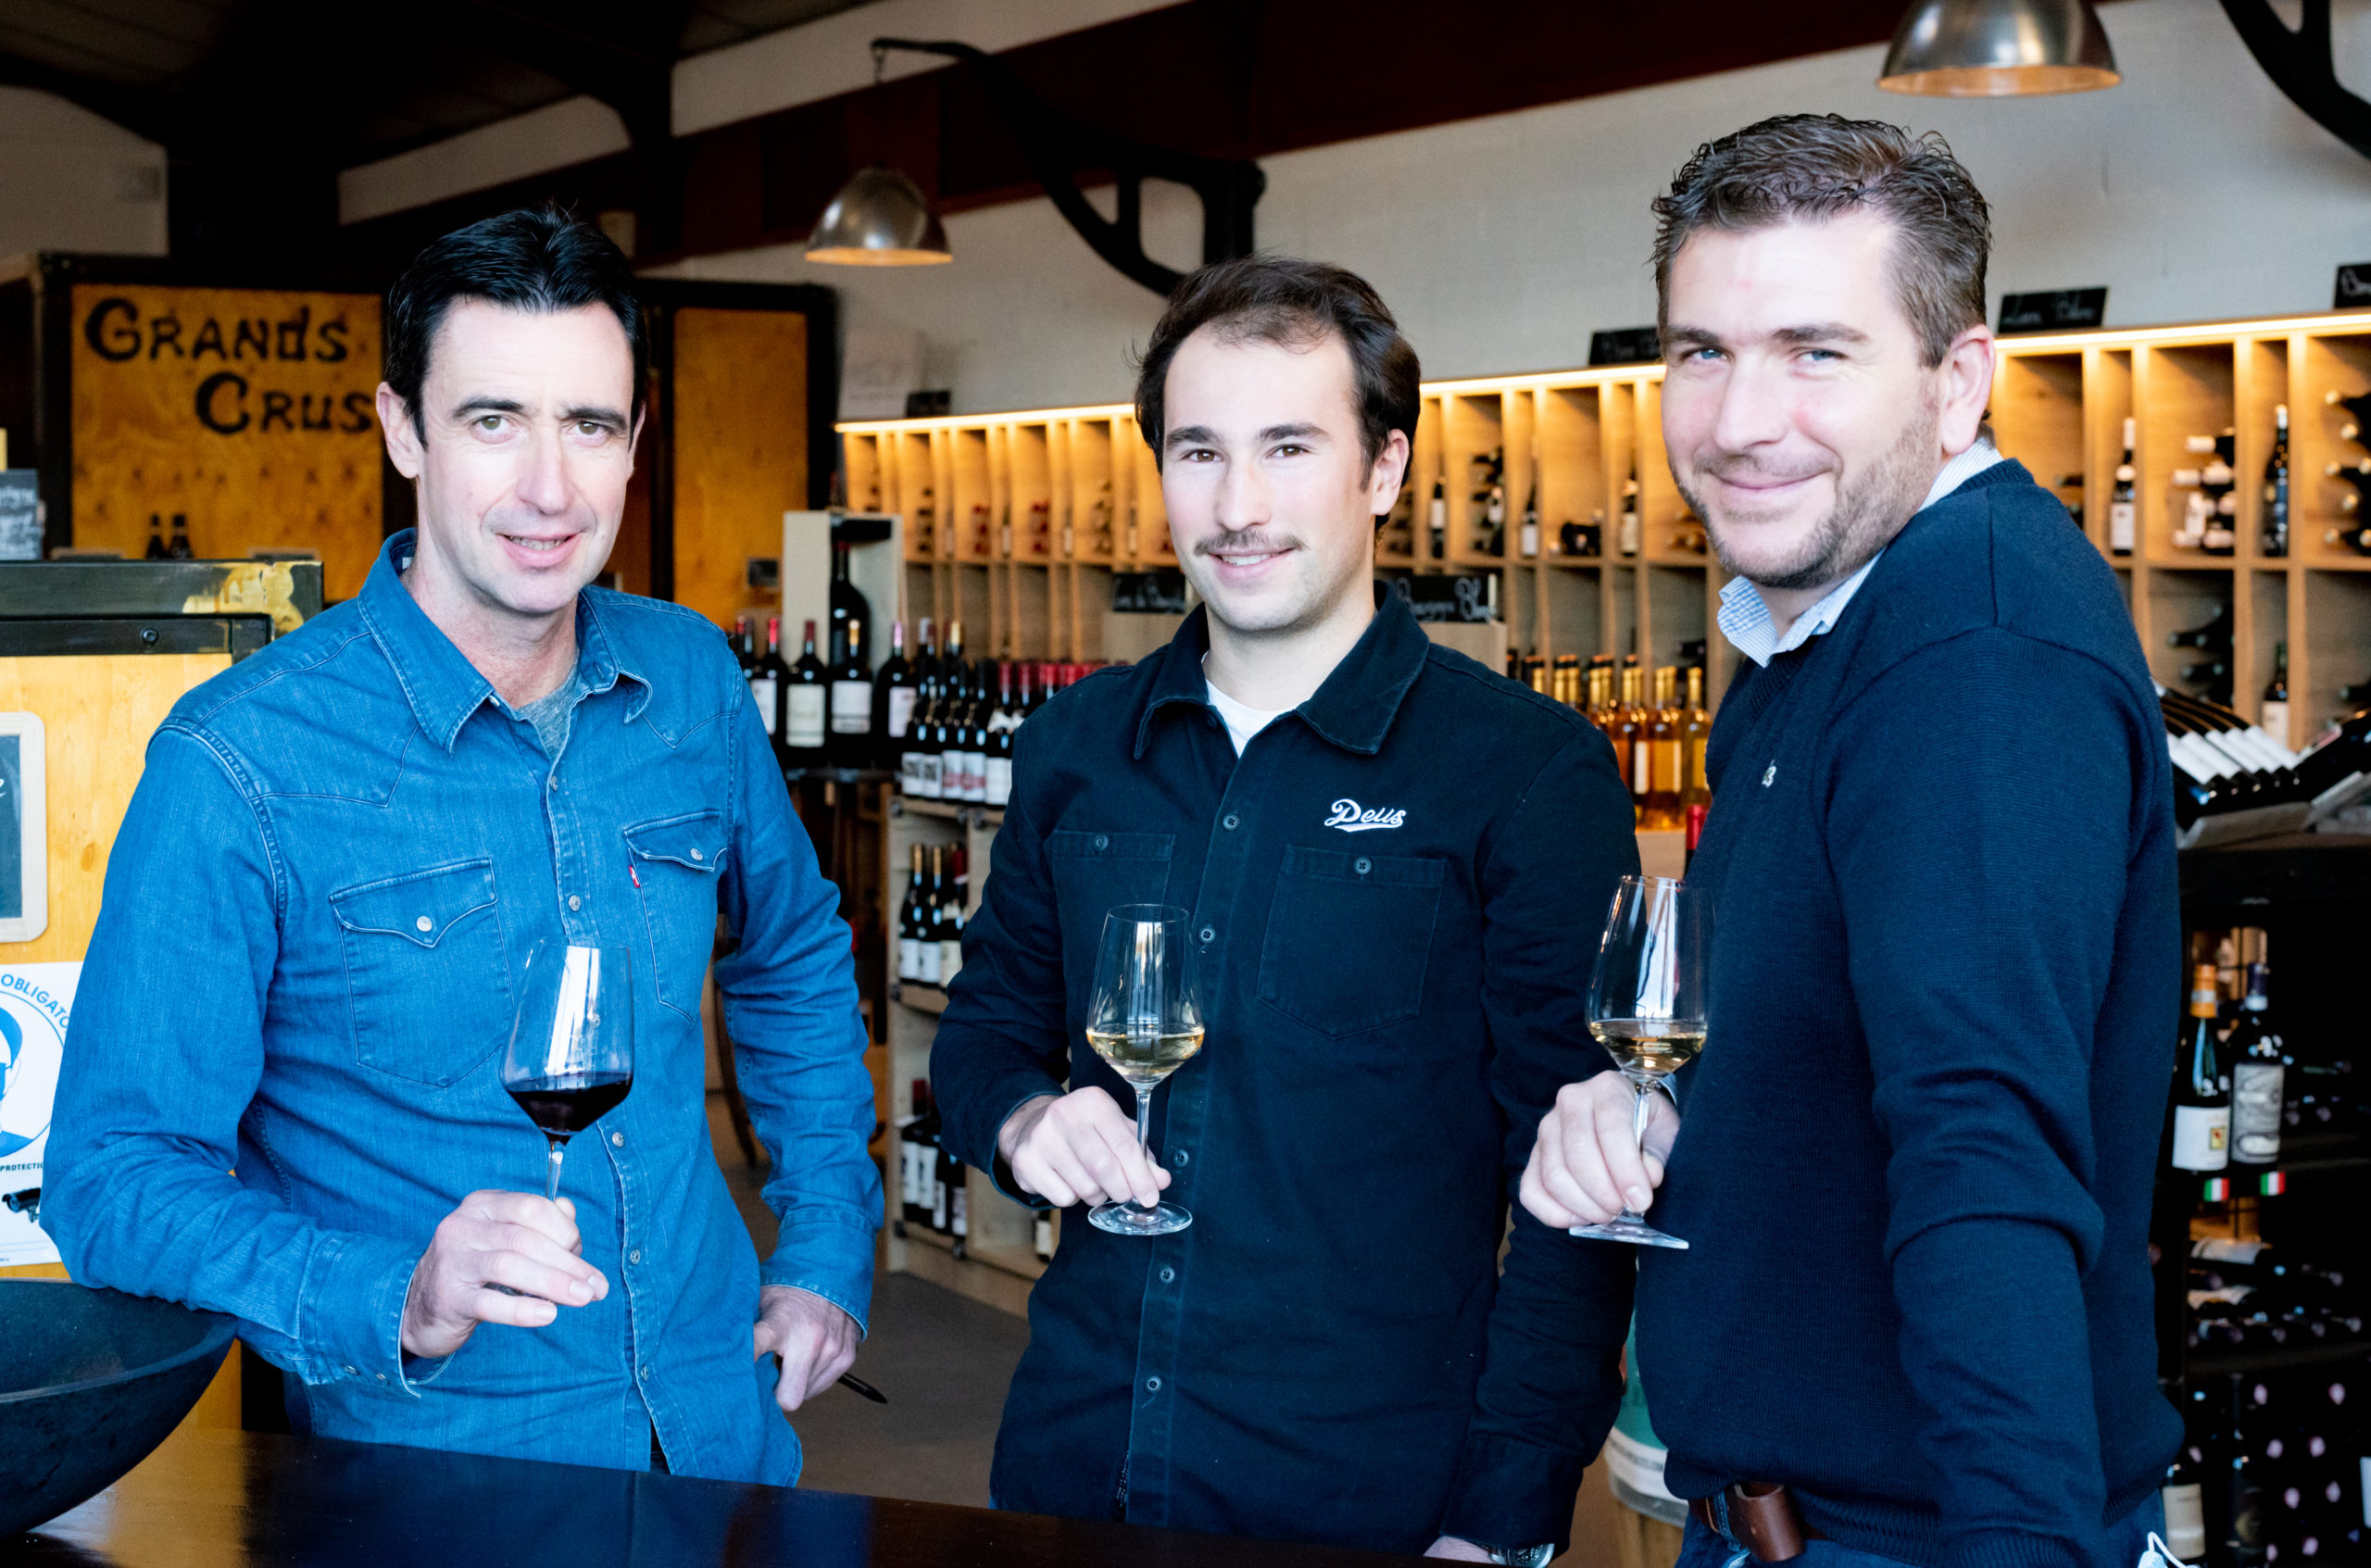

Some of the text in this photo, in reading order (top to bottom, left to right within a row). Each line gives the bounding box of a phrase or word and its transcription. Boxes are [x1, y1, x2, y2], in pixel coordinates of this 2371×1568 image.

[194, 371, 373, 435] CRUS
[1324, 798, 1406, 832] Deus
[1, 974, 69, 1032] OBLIGATO
